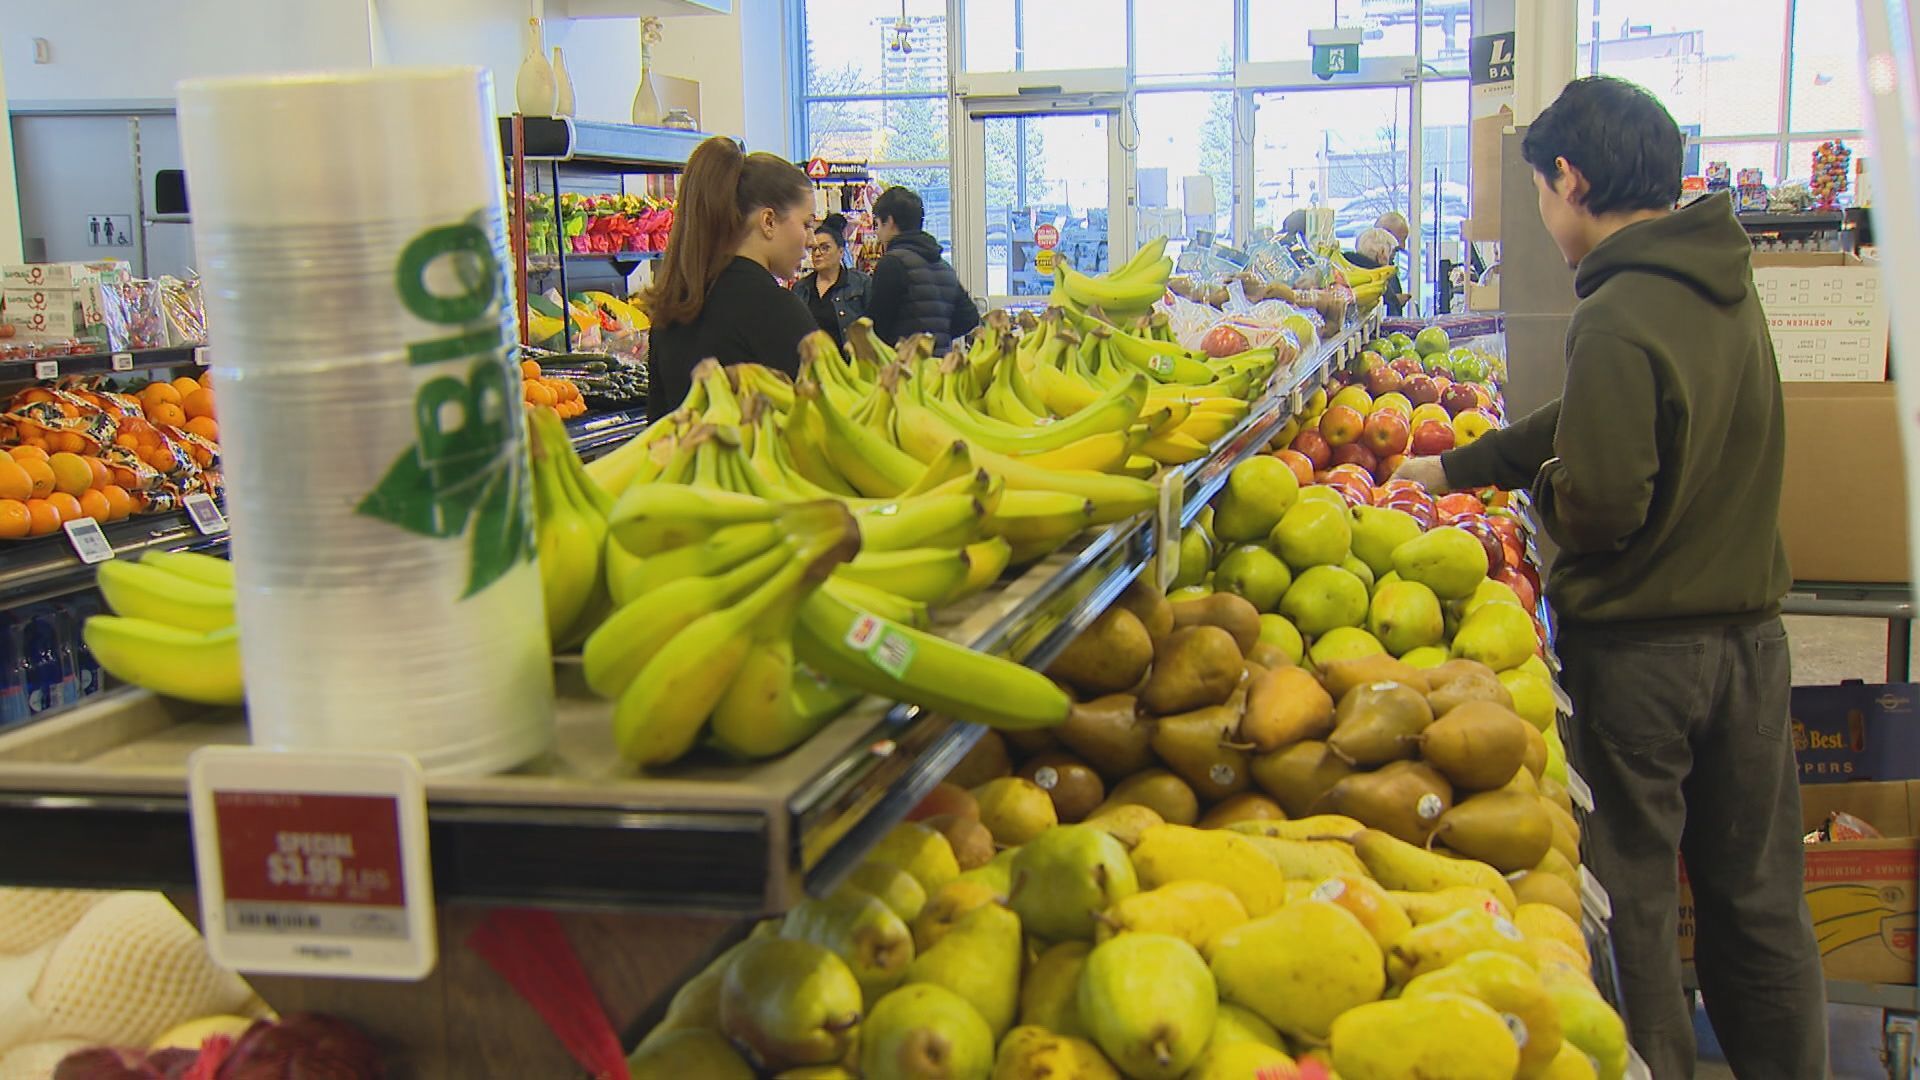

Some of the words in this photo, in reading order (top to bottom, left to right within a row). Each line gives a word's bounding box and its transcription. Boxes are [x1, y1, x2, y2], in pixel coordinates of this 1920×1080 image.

[1489, 65, 1515, 79] BA
[1786, 319, 1833, 327] NORTHERN
[396, 223, 514, 463] BIO
[1810, 731, 1843, 749] Best
[1798, 761, 1854, 775] PERS
[277, 831, 354, 858] SPECIAL
